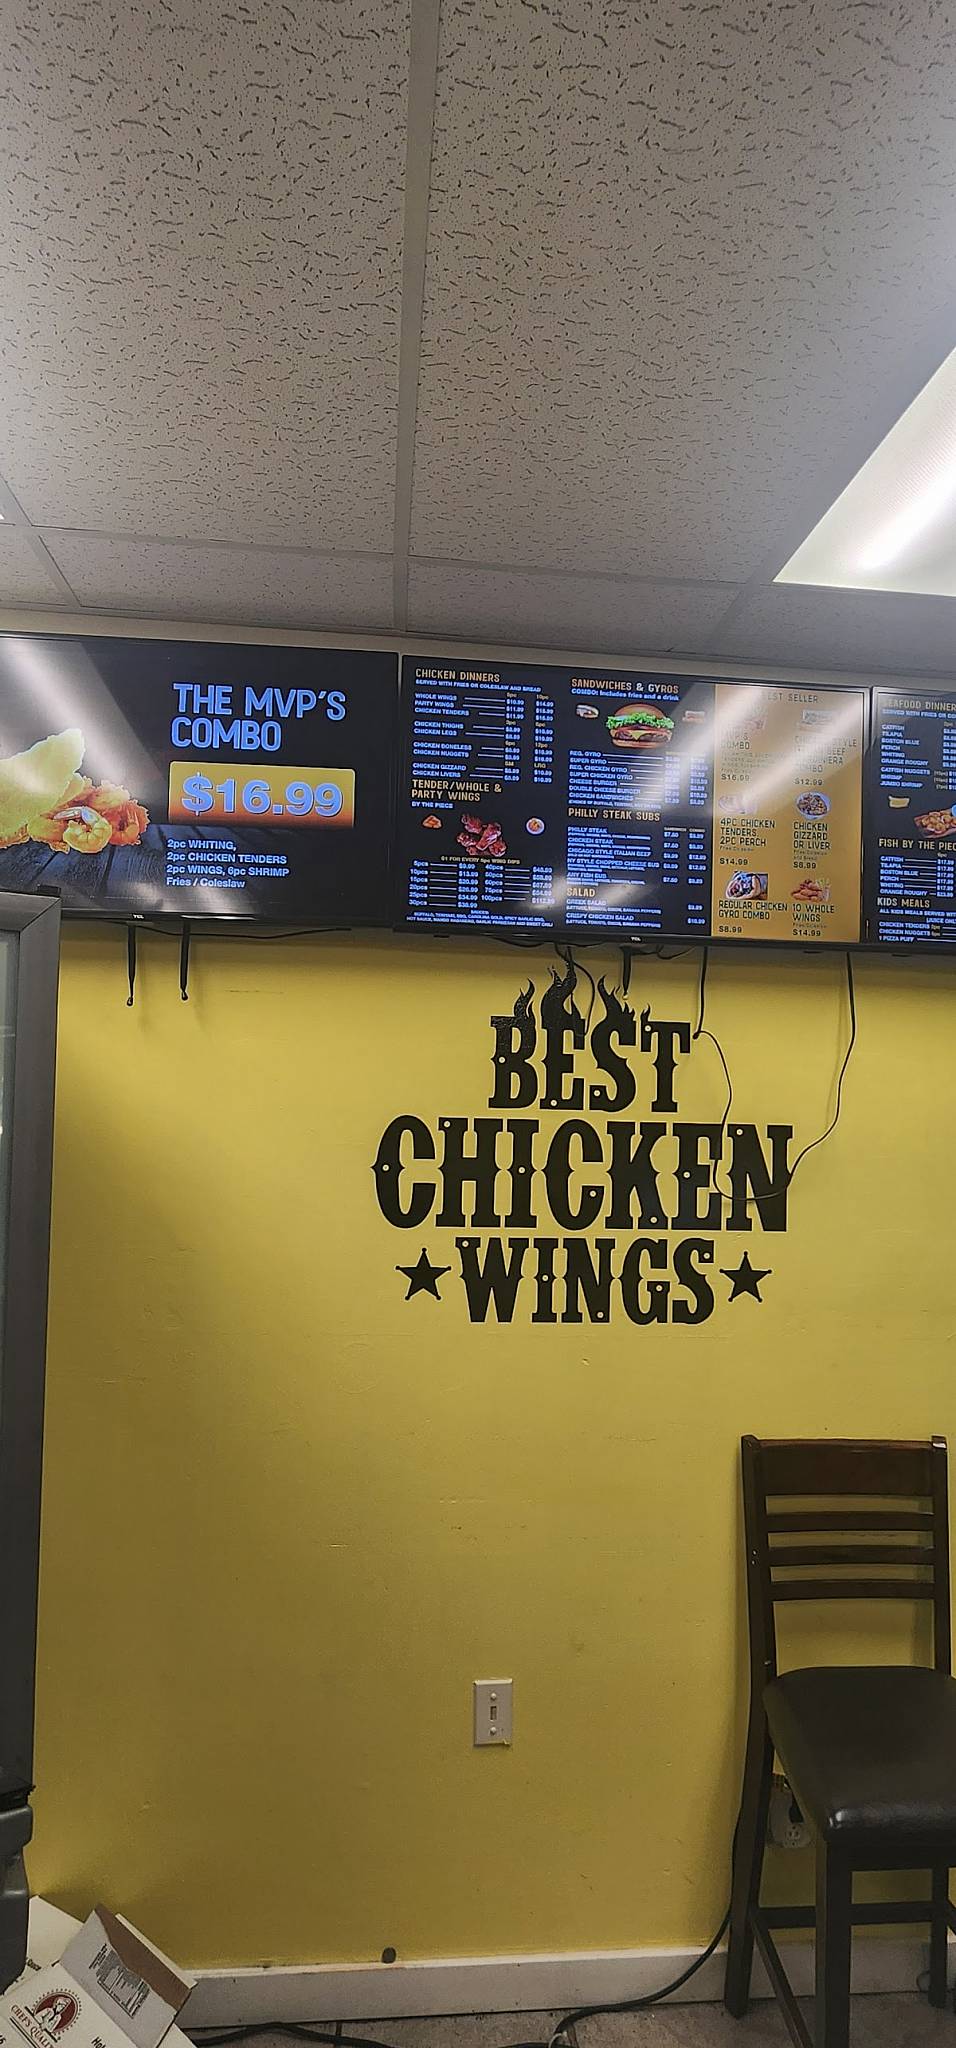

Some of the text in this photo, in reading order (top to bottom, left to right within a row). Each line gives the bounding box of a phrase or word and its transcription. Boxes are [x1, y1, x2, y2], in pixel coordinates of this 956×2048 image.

[416, 668, 500, 682] CHICKEN DINNERS
[572, 679, 679, 694] SANDWICHES & GYROS
[173, 683, 346, 721] THE MVP'S
[788, 694, 818, 703] SELLER
[171, 717, 281, 751] COMBO
[412, 779, 502, 792] TENDER/WHOLE &
[182, 772, 343, 817] $16.99
[412, 789, 480, 801] PARTY WINGS
[568, 808, 660, 821] PHILLY STEAK SUBS
[720, 818, 776, 828] 4PC CHICKEN
[794, 822, 828, 832] CHICKEN
[720, 836, 766, 846] 2PC PERCH
[794, 831, 828, 840] GIZZARD
[168, 839, 236, 851] 2pc WHITING,
[794, 840, 830, 850] OR LIVER
[879, 838, 898, 848] FISH
[902, 840, 914, 848] BY
[918, 841, 935, 850] THE
[167, 852, 287, 864] 2pc CHICKEN TENDERS
[166, 864, 290, 876] 2pc WINGS, 6pc SHRIMP
[166, 877, 191, 886] Fries
[200, 878, 246, 888] Coleslaw
[566, 888, 596, 897] SALAD
[719, 901, 788, 911] REGULAR CHICKEN
[793, 904, 834, 914] 10 WHOLE
[877, 898, 930, 908] KIDS MEALS
[719, 910, 770, 920] GYRO COMBO
[793, 913, 820, 922] WINGS
[793, 928, 821, 936] $14.99
[489, 1012, 691, 1113] BEST
[370, 1115, 793, 1233] CHICKEN
[455, 1237, 715, 1325] WINGS
